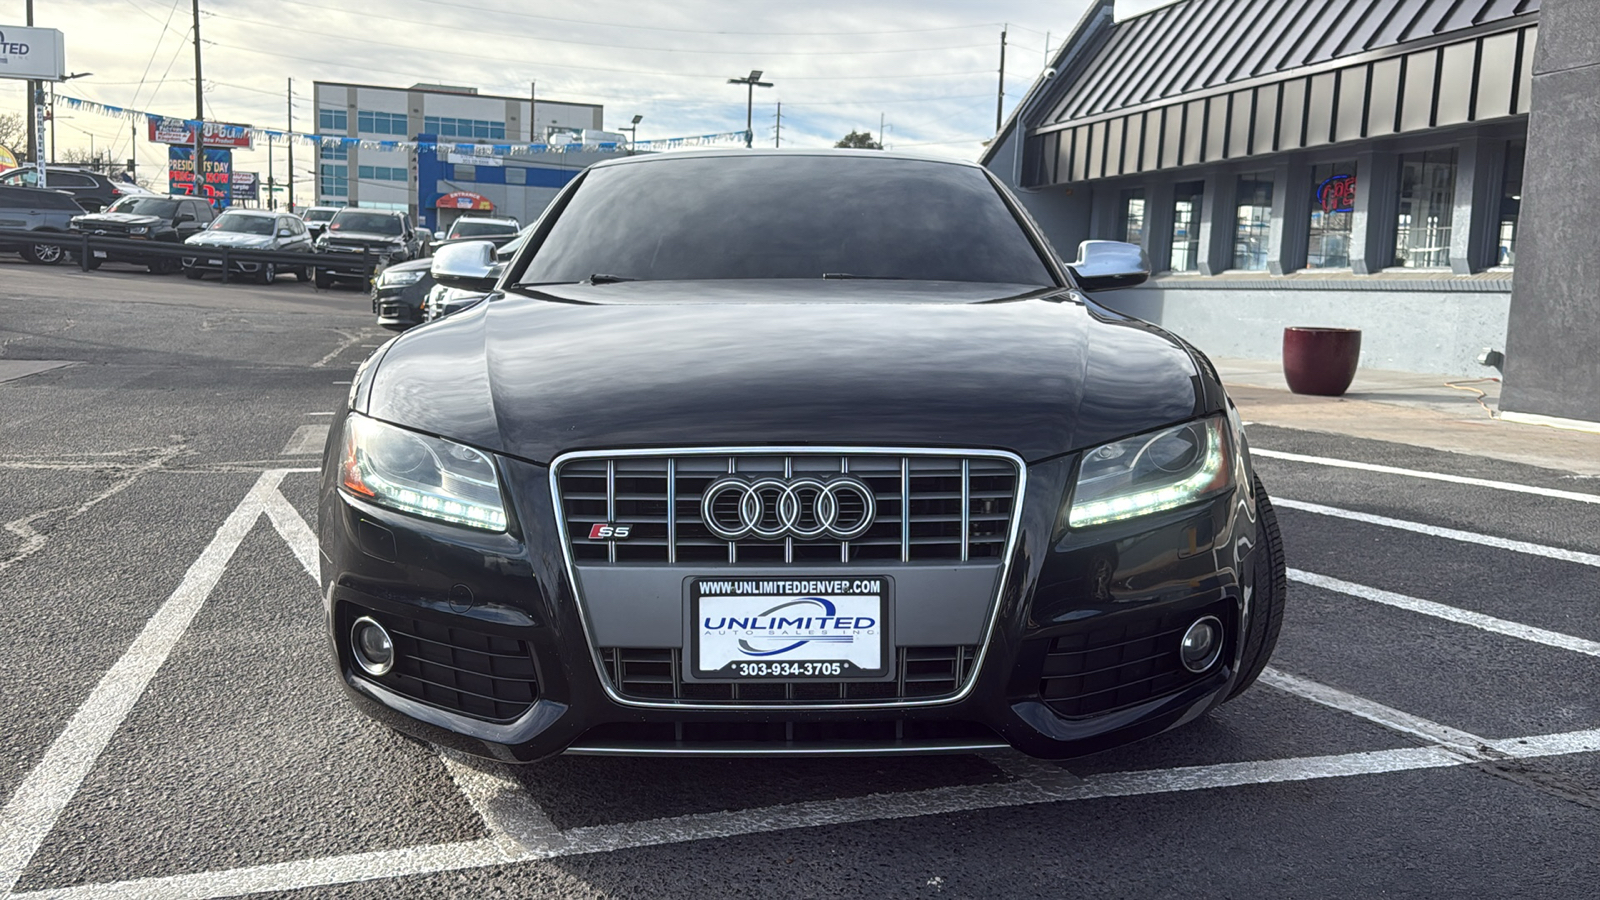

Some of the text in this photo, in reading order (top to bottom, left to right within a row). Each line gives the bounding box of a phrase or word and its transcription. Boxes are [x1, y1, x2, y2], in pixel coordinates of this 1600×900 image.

[214, 161, 229, 173] DAY
[597, 526, 630, 537] S5
[699, 580, 880, 594] WWW.UNLIMITEDDENVER.COM
[704, 616, 876, 630] UNLIMITED
[739, 662, 841, 676] 303-934-3705
